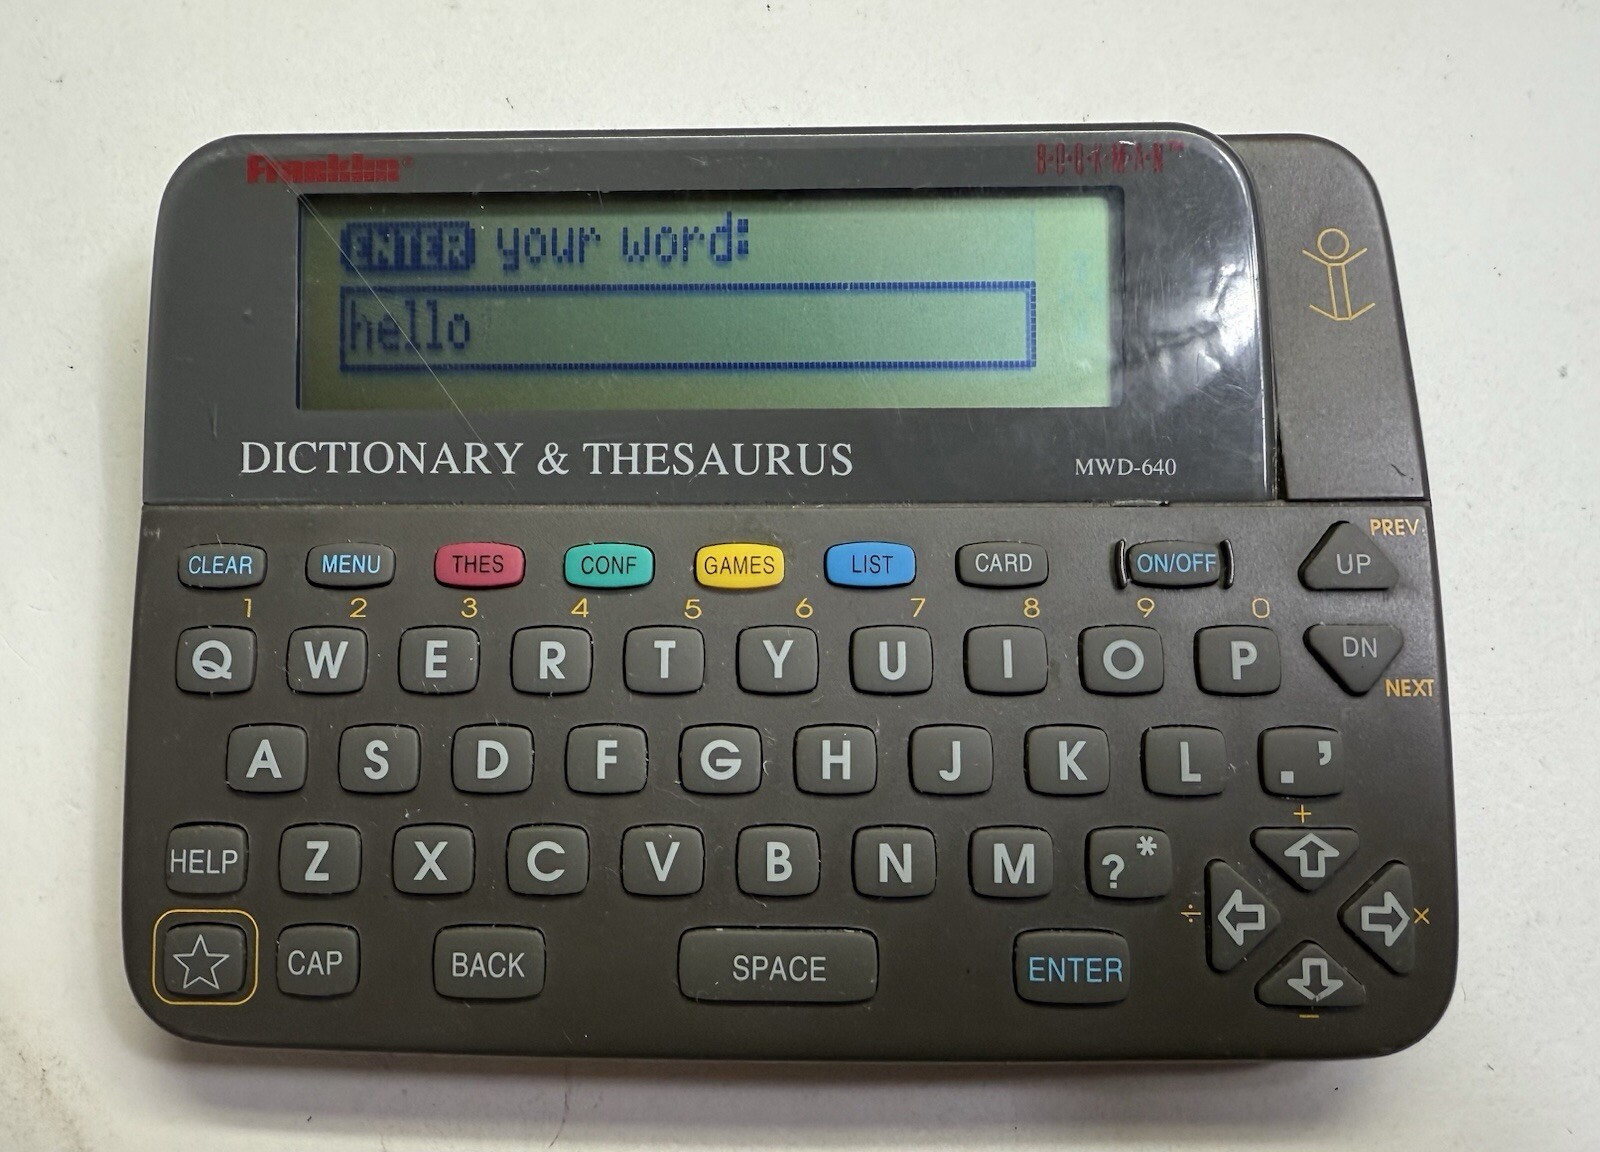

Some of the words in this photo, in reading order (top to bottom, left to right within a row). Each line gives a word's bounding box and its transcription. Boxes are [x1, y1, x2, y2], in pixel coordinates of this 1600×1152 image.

[344, 223, 473, 268] ENTER
[497, 226, 601, 272] your
[622, 211, 750, 263] word:
[350, 300, 471, 352] hello
[241, 442, 523, 474] DICTIONARY
[538, 443, 569, 474] &
[583, 443, 852, 475] THESAURUS
[1076, 459, 1176, 475] MWD-640
[1368, 518, 1423, 540] PREV
[189, 556, 252, 574] CLEAR
[322, 555, 380, 573] MENU
[452, 555, 503, 573] THES
[582, 556, 636, 574] CONF
[704, 556, 774, 574] GAMES
[853, 555, 893, 573] LIST
[976, 553, 1032, 572] CARD
[1137, 554, 1219, 572] ON/OFF
[1337, 554, 1371, 574] UP
[245, 599, 251, 617] 1
[350, 598, 367, 617] 2
[461, 598, 477, 617] 3
[571, 598, 589, 617] 4
[685, 599, 702, 619] 5
[796, 598, 813, 618] 6
[911, 598, 925, 617] 7
[1024, 598, 1040, 618] 8
[1137, 598, 1154, 617] 9
[193, 640, 232, 679] Q
[304, 641, 348, 678] W
[426, 640, 448, 678] E
[540, 641, 565, 679] R
[654, 641, 676, 678] T
[763, 640, 793, 678] Y
[879, 641, 906, 680] U
[1003, 639, 1012, 678] I
[1103, 640, 1144, 679] O
[1231, 641, 1257, 679] P
[1343, 637, 1377, 657] DN
[1386, 676, 1437, 696] NEXT
[246, 739, 282, 778] A
[364, 740, 388, 779] S
[478, 740, 508, 778] D
[597, 740, 617, 779] F
[701, 740, 741, 780] G
[823, 740, 850, 779] H
[939, 741, 961, 782] J
[1059, 741, 1087, 780] K
[1180, 742, 1201, 782] L
[171, 849, 238, 873] HELP
[305, 841, 329, 881] Z
[414, 842, 448, 880] X
[527, 841, 565, 881] C
[645, 842, 680, 881] V
[767, 842, 792, 881] B
[879, 843, 911, 882] N
[993, 843, 1034, 883] M
[1102, 854, 1124, 888] ?
[289, 950, 342, 975] CAP
[453, 952, 524, 977] BACK
[733, 955, 826, 981] SPACE
[1030, 957, 1122, 982] ENTER
